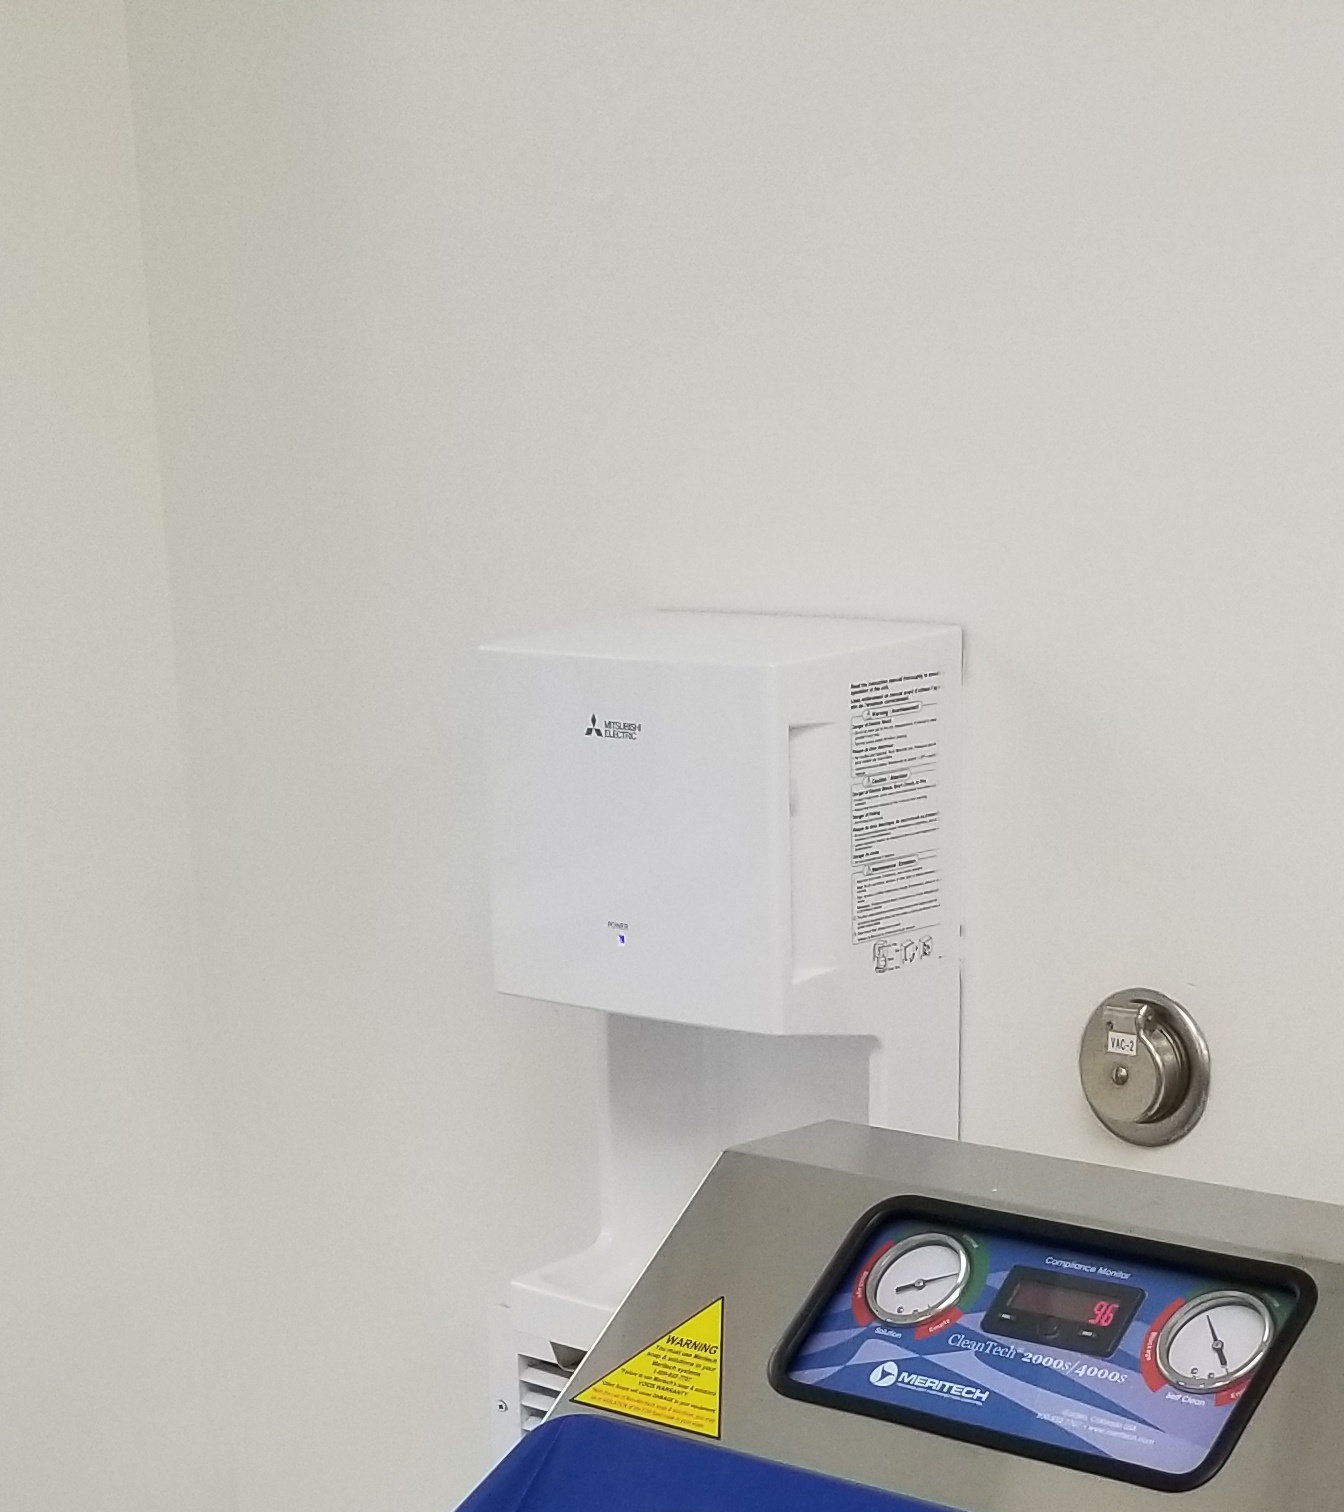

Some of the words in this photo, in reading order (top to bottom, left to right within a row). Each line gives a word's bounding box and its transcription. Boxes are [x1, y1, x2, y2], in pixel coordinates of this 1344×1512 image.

[604, 720, 642, 732] MITSUBISHI
[604, 729, 637, 740] ELECTRIC
[1110, 1037, 1134, 1052] VAC-2
[1045, 1256, 1097, 1273] Compliance
[1097, 1266, 1132, 1280] Monitor
[1088, 1301, 1119, 1326] 96
[874, 1326, 902, 1339] Solution
[666, 1334, 719, 1355] WARNING
[1022, 1351, 1128, 1383] 2000s/4000s
[898, 1372, 989, 1402] MERITECH
[1165, 1391, 1181, 1401] Self
[1182, 1395, 1206, 1406] Clean
